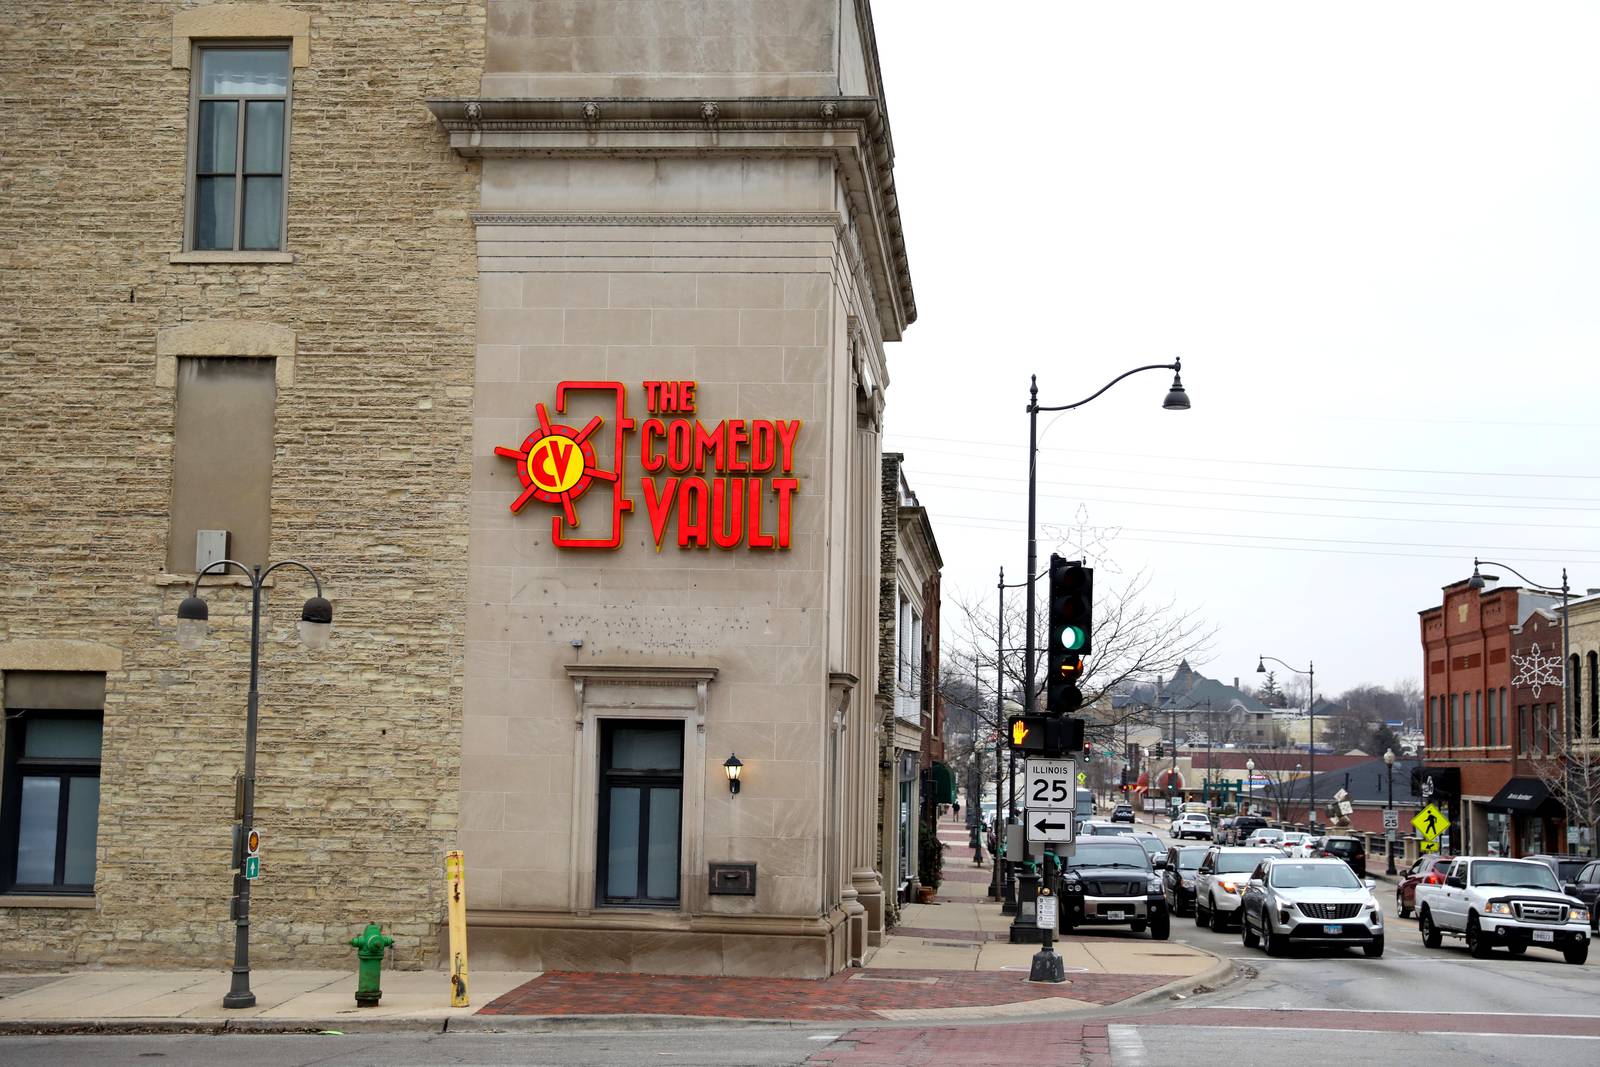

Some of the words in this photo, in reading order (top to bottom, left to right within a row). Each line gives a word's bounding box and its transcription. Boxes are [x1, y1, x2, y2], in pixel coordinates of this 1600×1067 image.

[642, 381, 697, 413] THE
[641, 419, 801, 473] COMEDY
[531, 441, 574, 487] CV
[641, 477, 799, 551] VAULT
[1032, 766, 1068, 775] ILLINOIS
[1032, 778, 1068, 803] 25
[1384, 819, 1398, 827] 25
